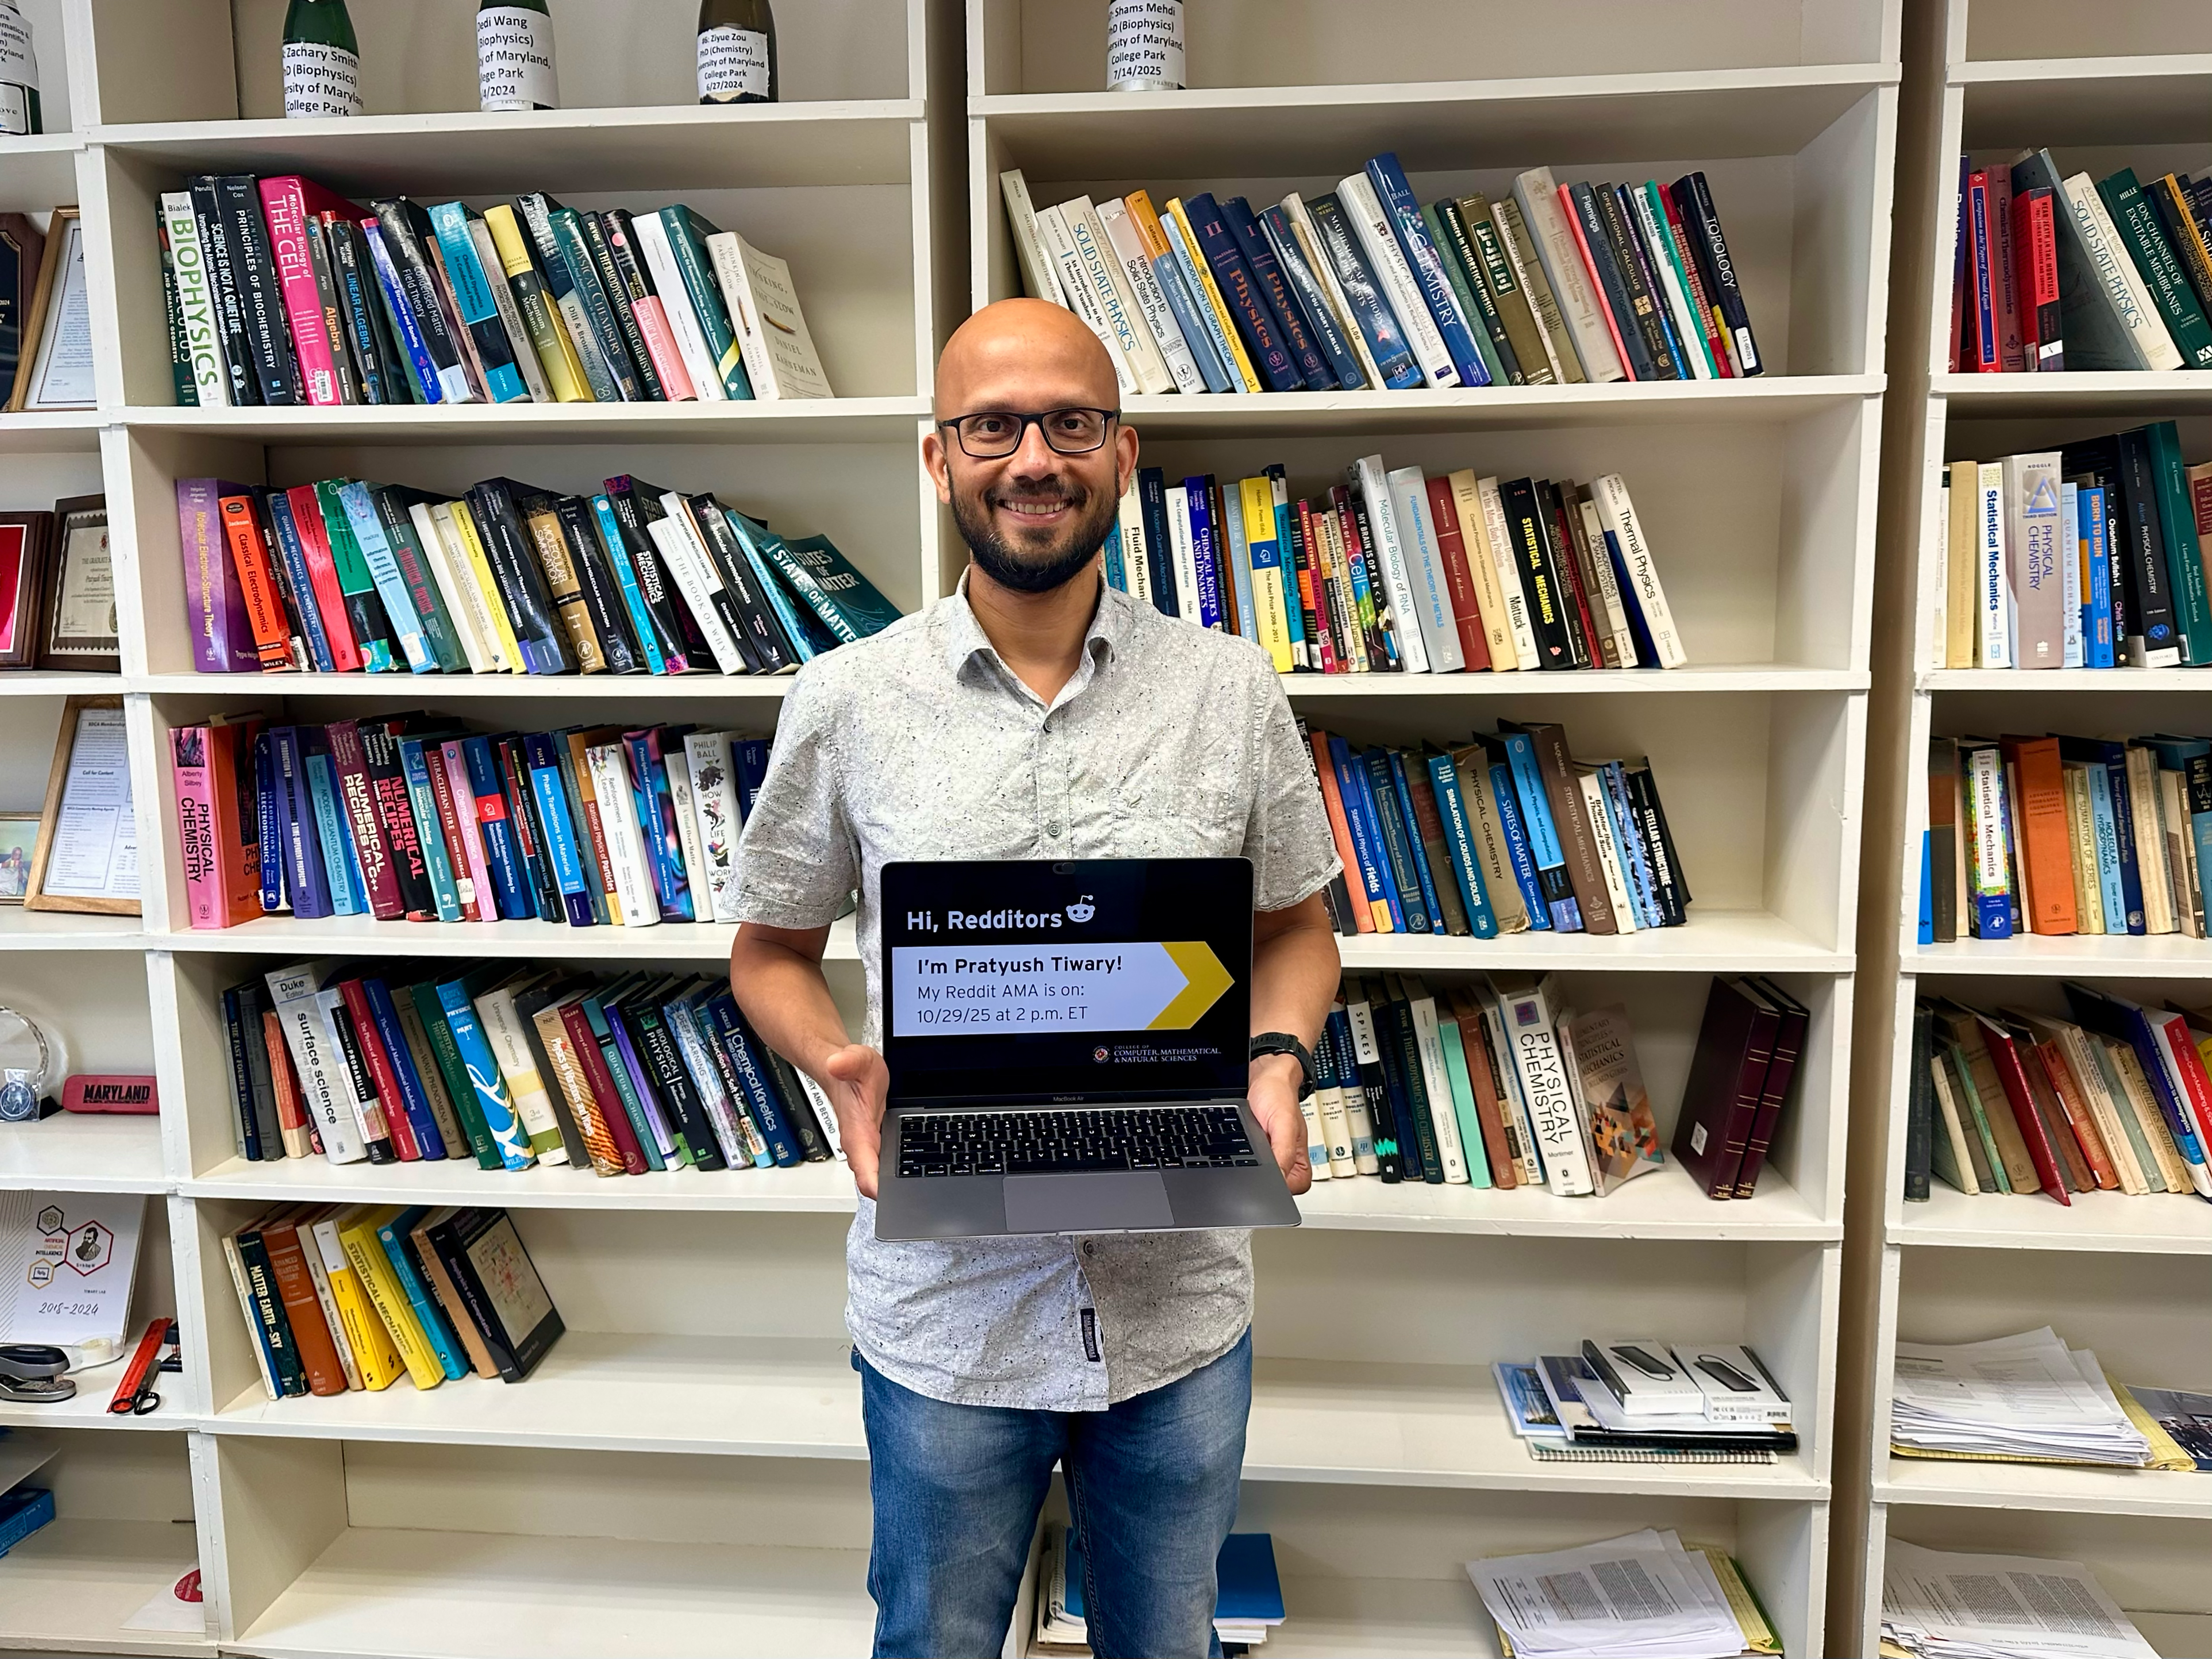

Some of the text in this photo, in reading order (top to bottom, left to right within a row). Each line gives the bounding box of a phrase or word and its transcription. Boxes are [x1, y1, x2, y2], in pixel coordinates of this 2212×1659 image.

[494, 15, 527, 29] Wang
[1115, 3, 1175, 16] Shams Mehdi
[1119, 18, 1174, 33] (Biophysics)
[287, 46, 327, 61] Zachary
[485, 50, 550, 69] of Maryland,
[710, 45, 752, 55] (Chemistry)
[711, 34, 730, 43] Ziyue
[1112, 50, 1165, 65] College Park
[1130, 34, 1183, 53] of Maryland,
[293, 64, 357, 88] (Biophysics)
[498, 68, 524, 78] Park
[705, 70, 727, 80] College
[729, 58, 764, 68] Maryland
[1114, 65, 1161, 80] 7/14/2025
[287, 100, 349, 116] College Park
[707, 81, 742, 92] 6/27/2024
[168, 203, 191, 212] Bialek
[1582, 195, 1599, 232] Flemings
[2119, 186, 2138, 200] HILLE
[211, 223, 227, 257] SCIENCE
[269, 195, 300, 286] THE CELL
[289, 194, 301, 234] Molecular
[296, 237, 307, 266] Biology
[1706, 217, 1735, 286] TOPOLOGY
[2136, 202, 2183, 284] ION CHANNELS OF
[219, 268, 232, 284] NOT
[1137, 253, 1166, 312] Introduction to
[2072, 200, 2142, 328] SOLID STATE PHYSICS
[2126, 208, 2182, 315] EXCITABLE MEMBRANES
[172, 219, 217, 384] BIOPHYSICS
[224, 295, 238, 317] QUIET
[236, 210, 274, 367] PRINCIPLES OF BIOCHEMISTRY
[1073, 223, 1134, 350] SOLID STATE PHYSICS
[1127, 260, 1164, 340] Solid State Physics
[1230, 269, 1271, 347] Physics
[229, 319, 241, 333] LIFE
[326, 307, 340, 350] Algebra
[1267, 273, 1306, 349] Physics
[2091, 495, 2102, 557] BORN TO RUN
[1348, 553, 1367, 583] Cell
[1379, 499, 1393, 542] Molecular
[1389, 546, 1400, 580] Biology
[1398, 593, 1410, 614] RNA
[1522, 518, 1553, 623] STATISTICAL MECHANICS
[1620, 508, 1655, 598] Thermal Physics
[1987, 491, 1999, 610] Statistical Mechanics
[2028, 526, 2039, 589] CHEMISTRY
[2042, 525, 2052, 578] PHYSICAL
[238, 534, 268, 633] Classical Electrodynamics
[636, 553, 657, 603] MECHANICS
[643, 551, 664, 601] STATISTICAL
[1509, 596, 1525, 629] Mattuck
[694, 741, 717, 749] PHILIP
[697, 750, 717, 758] BALL
[379, 779, 404, 850] RECIPES
[702, 791, 722, 799] HOW
[181, 798, 200, 882] CHEMISTRY
[198, 804, 213, 876] PHYSICAL
[345, 776, 378, 891] RECIPES in C++
[354, 774, 384, 872] NUMERICAL
[392, 777, 422, 878] NUMERICAL
[542, 774, 551, 795] Phase
[548, 796, 560, 833] Transitions
[559, 843, 571, 876] Materials
[710, 830, 725, 838] LIFE
[1502, 800, 1531, 879] STATES OF MATTER
[1981, 770, 1996, 876] Statistical Mechanics
[1644, 809, 1671, 885] STELLAR STRUCTURE
[908, 910, 1062, 933] Hi, Redditors
[280, 980, 305, 992] Duke
[918, 956, 1122, 976] I'm Pratyush Tiwary!
[285, 990, 304, 999] Editor
[917, 1006, 1088, 1024] 10/29/25 at 2 p.m. ET
[918, 983, 1084, 1002] My Reddit AMA is on:
[647, 1032, 671, 1078] PHYSICS
[656, 1028, 678, 1075] BIOLOGICAL
[1356, 1012, 1371, 1056] SPIKES
[297, 1013, 336, 1123] surface science
[705, 1024, 745, 1115] Introduction to Soft Matter
[732, 1035, 776, 1130] Chemical Kinetics
[1520, 1033, 1558, 1143] CHEMISTRY
[1536, 1031, 1571, 1141] PHYSICAL
[83, 1084, 151, 1100] MARYLAND
[250, 1265, 268, 1297] MATTER
[348, 1243, 380, 1300] STATISTICAL
[38, 1302, 99, 1316] 2018-2024
